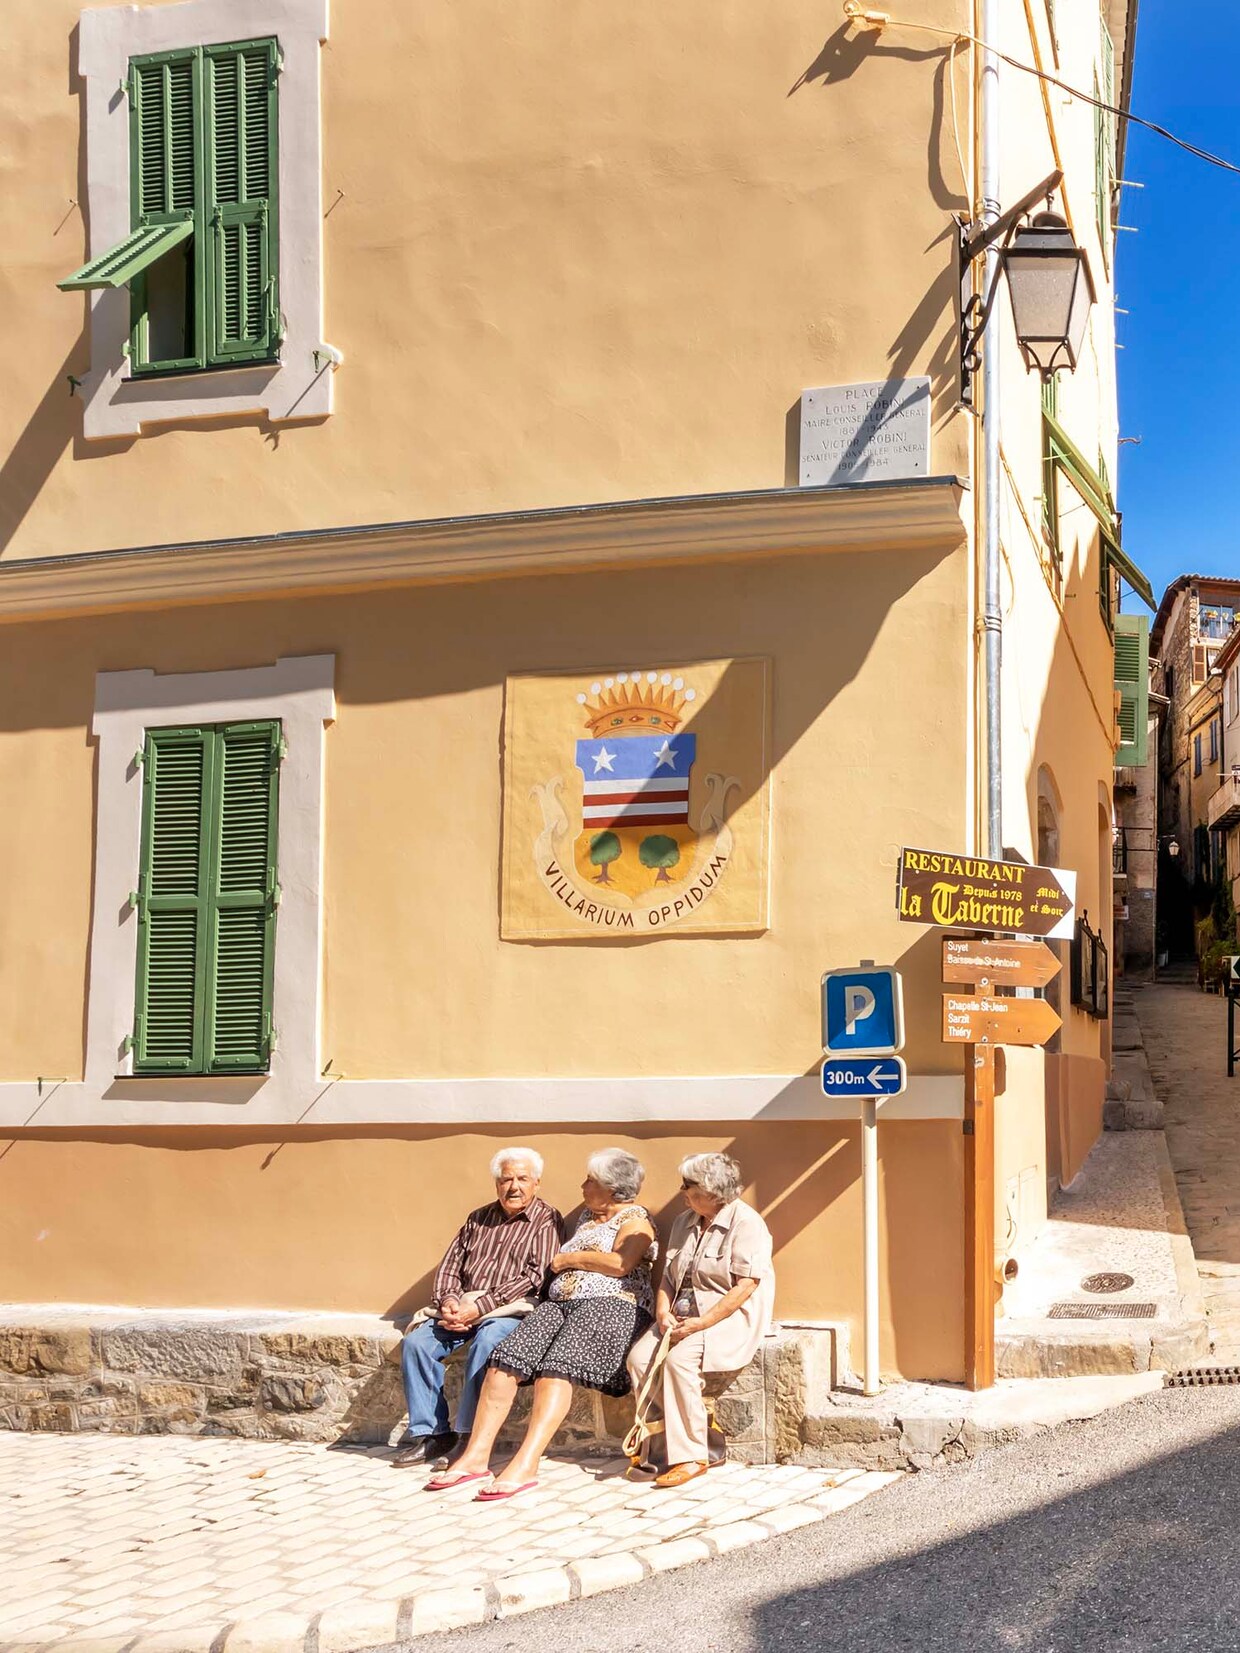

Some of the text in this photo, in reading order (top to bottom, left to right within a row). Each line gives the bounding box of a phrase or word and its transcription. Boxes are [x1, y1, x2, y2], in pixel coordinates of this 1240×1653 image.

[845, 386, 884, 400] PLACE
[825, 398, 905, 415] LOUIS ROBINI
[804, 417, 830, 428] MAIRE
[822, 432, 907, 450] VICTOR ROBINI
[904, 851, 1026, 884] RESTAURANT
[545, 855, 727, 928] VILLARIUM OPPIDUM
[963, 884, 1023, 902] Depuis 1978
[900, 881, 1024, 928] la Taverne
[1030, 902, 1039, 913] et
[947, 940, 969, 953] Suyet
[845, 985, 876, 1035] P
[948, 1000, 980, 1012] Chapelle
[826, 1071, 865, 1085] 300m
